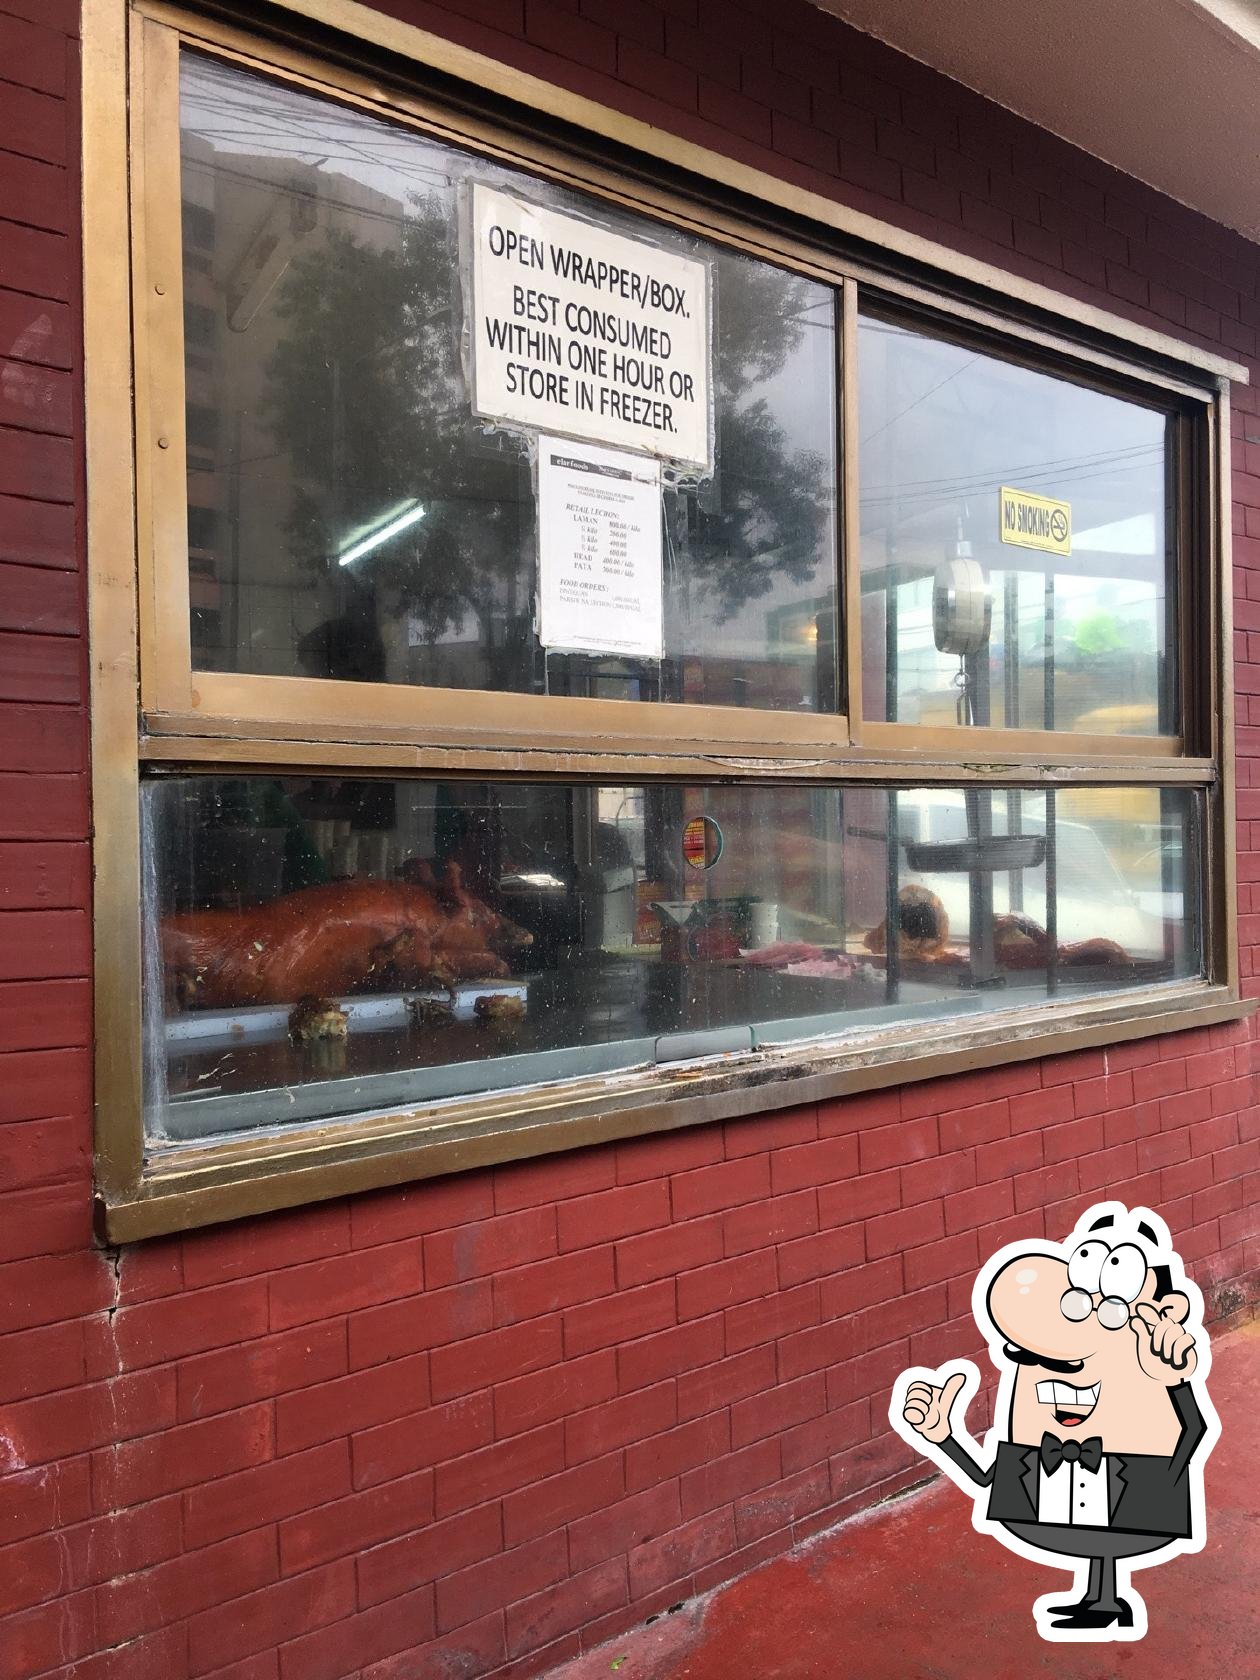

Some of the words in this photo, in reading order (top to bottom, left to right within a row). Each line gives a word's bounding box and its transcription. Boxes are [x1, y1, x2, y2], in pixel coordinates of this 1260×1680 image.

[489, 226, 544, 271] OPEN
[550, 244, 690, 318] WRAPPER/BOX.
[513, 285, 560, 326] BEST
[565, 302, 672, 360] CONSUMED
[485, 316, 562, 366] WITHIN
[568, 340, 608, 379] ONE
[613, 353, 665, 395] HOUR
[669, 371, 695, 403] OR
[506, 362, 569, 406] STORE
[575, 380, 594, 412] IN
[600, 387, 679, 433] FREEZER.
[565, 503, 589, 514] RETAIL
[1005, 501, 1015, 530] NO
[1018, 503, 1050, 538] SMOKING
[560, 578, 578, 588] FOOD
[574, 552, 593, 562] HEAD
